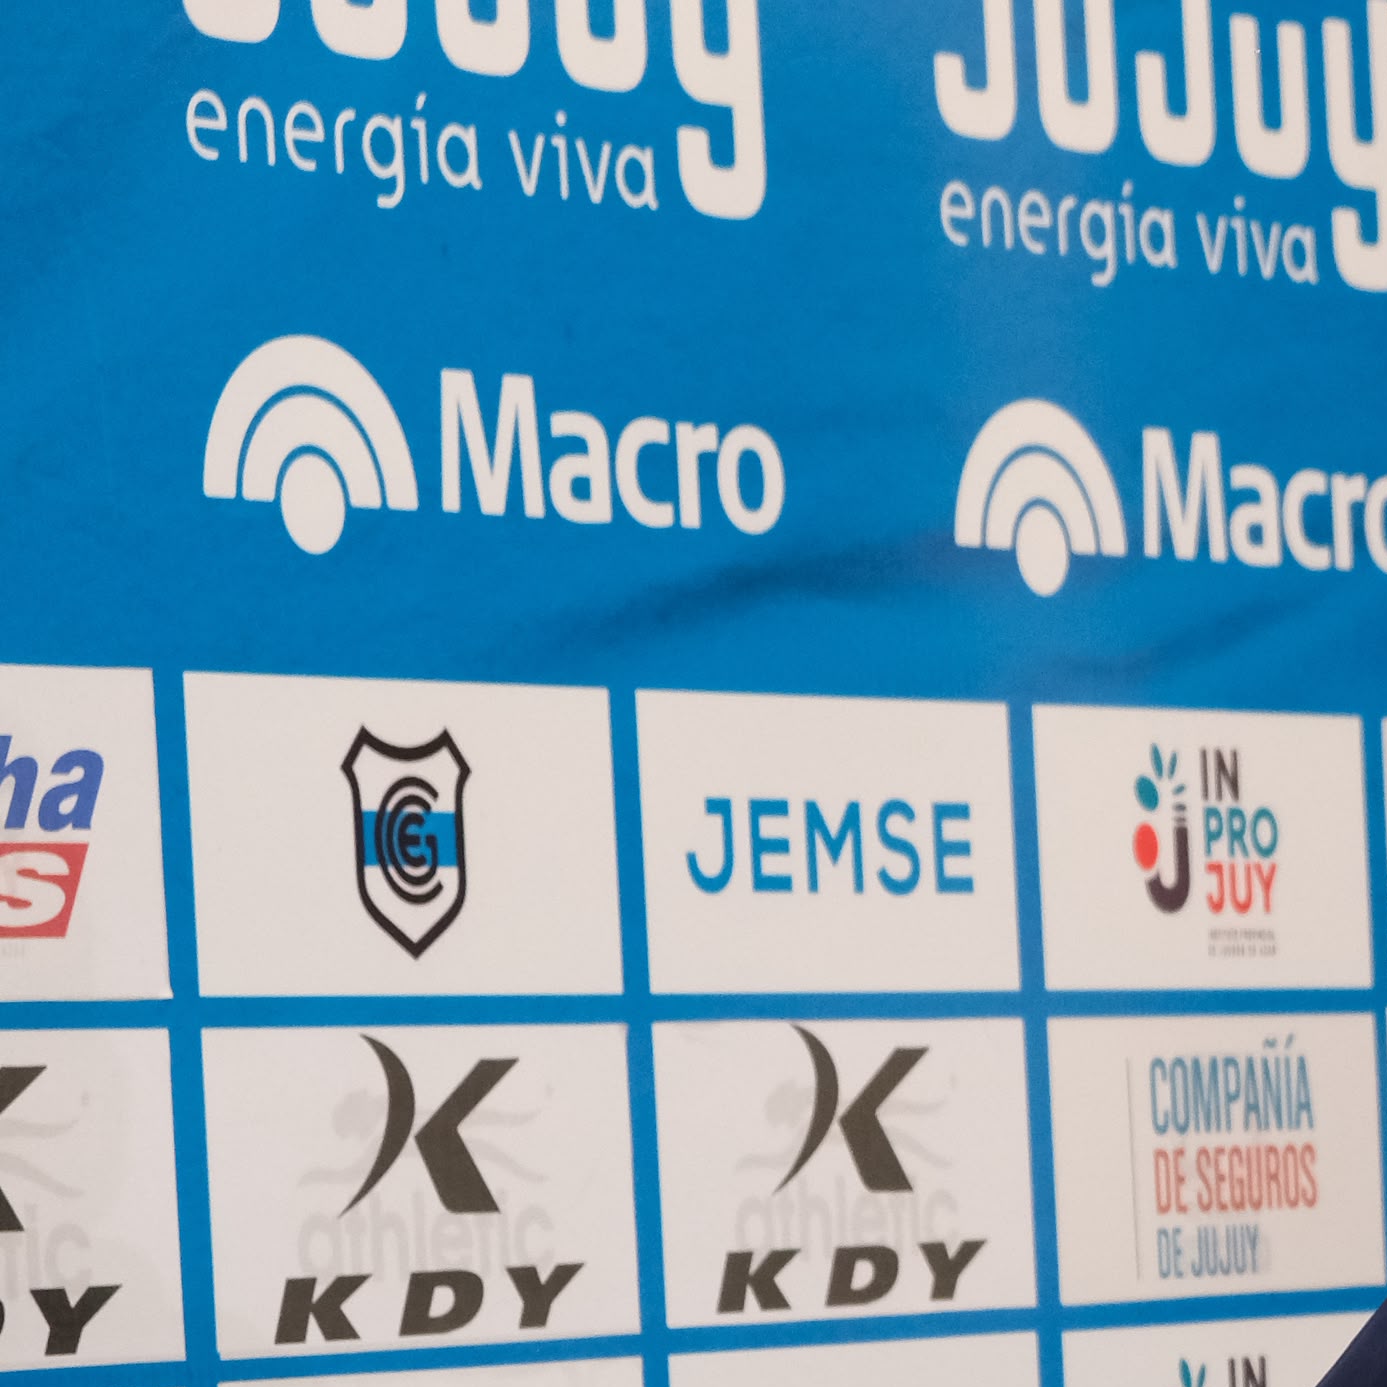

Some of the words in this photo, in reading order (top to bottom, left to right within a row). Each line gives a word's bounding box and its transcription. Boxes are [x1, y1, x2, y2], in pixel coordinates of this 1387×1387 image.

[185, 88, 482, 209] energía
[508, 110, 659, 211] viva
[938, 179, 1178, 287] energía
[1195, 195, 1319, 285] viva
[440, 368, 785, 536] Macro
[1200, 747, 1241, 803] IN
[685, 797, 975, 896] JEMSE
[1204, 806, 1279, 860] PRO
[1205, 861, 1278, 916] JUY
[1150, 1033, 1315, 1135] COMPAÑÍA
[1153, 1146, 1189, 1215] DE
[1195, 1142, 1319, 1213] SEGUROS
[716, 1238, 989, 1315] KDY
[1156, 1226, 1185, 1279] DE
[1191, 1223, 1260, 1278] JUJUY
[0, 1283, 123, 1357] Y
[274, 1261, 585, 1345] KDY
